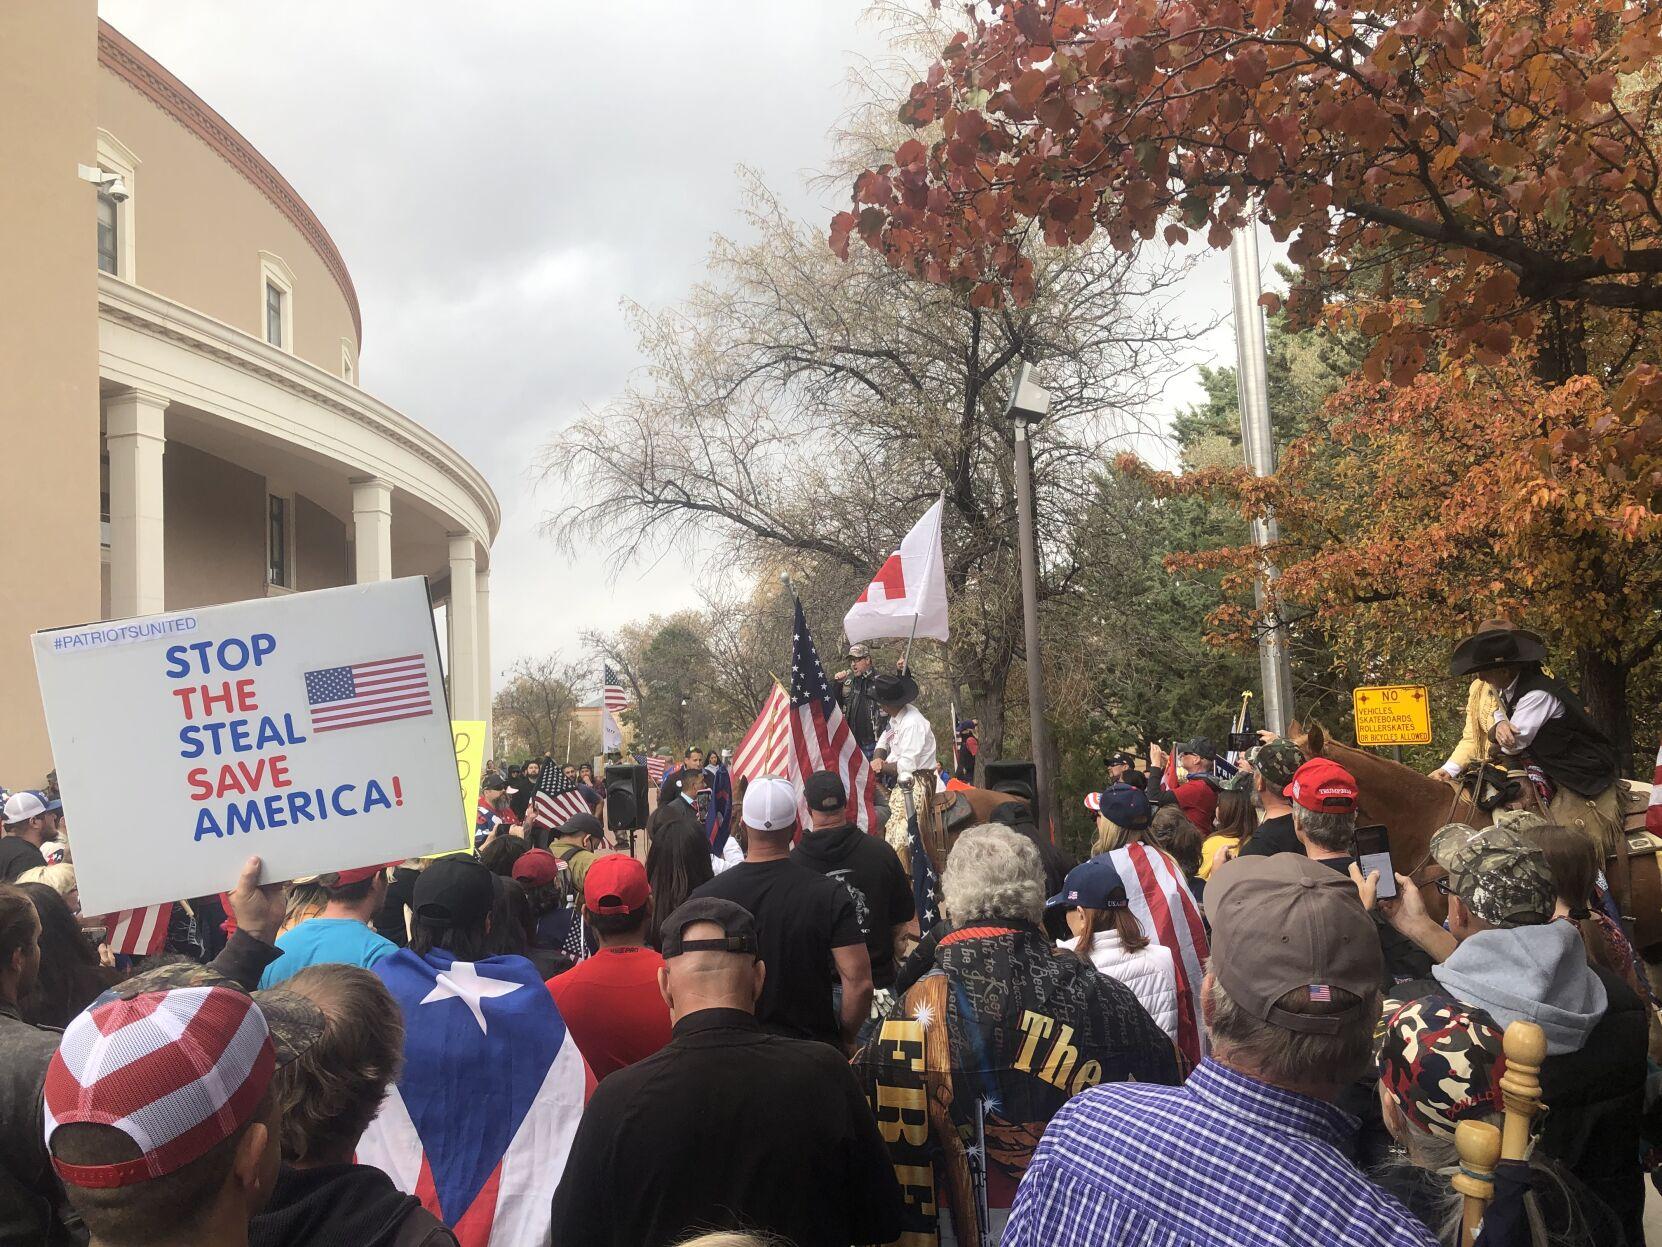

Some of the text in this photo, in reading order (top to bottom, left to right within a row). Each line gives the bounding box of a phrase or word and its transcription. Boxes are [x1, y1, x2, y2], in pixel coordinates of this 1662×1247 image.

[54, 617, 196, 649] #PATRIOTSUNITED
[166, 633, 277, 678] STOP
[173, 678, 259, 720] THE
[1382, 691, 1398, 701] NO
[179, 713, 307, 758] STEAL
[1360, 724, 1415, 732] ROLLERSKATES
[187, 754, 292, 801] SAVE
[193, 776, 403, 842] AMERICA!
[1010, 1009, 1102, 1097] The
